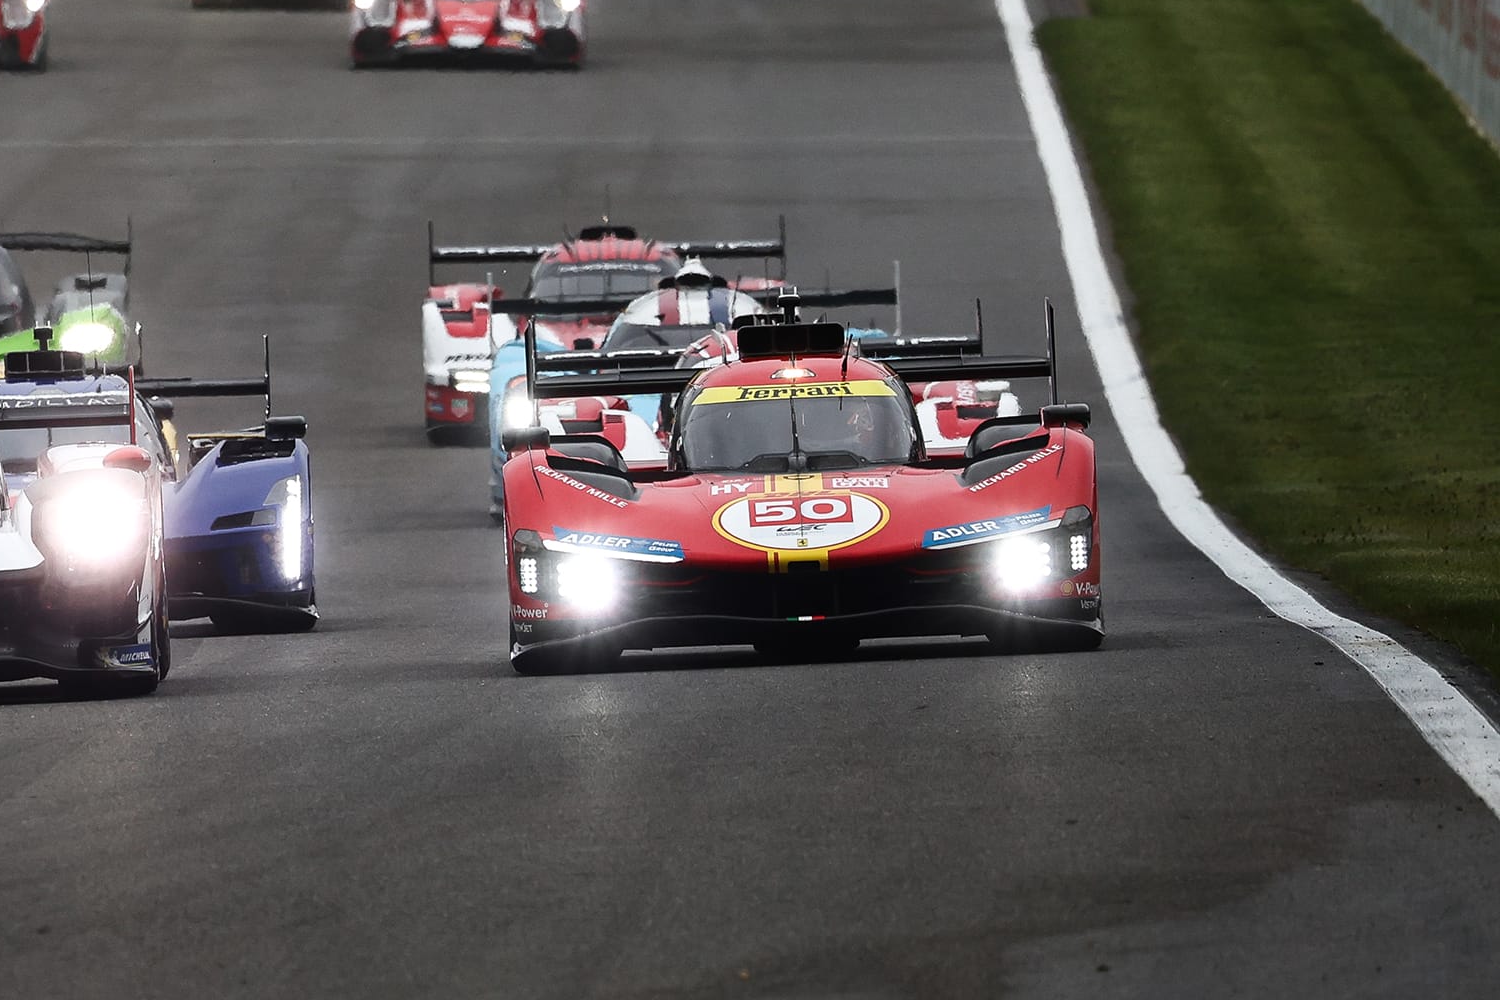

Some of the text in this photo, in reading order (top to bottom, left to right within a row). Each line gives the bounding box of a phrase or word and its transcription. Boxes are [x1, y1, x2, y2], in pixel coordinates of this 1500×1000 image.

[736, 382, 854, 400] Ferrari
[970, 444, 1063, 493] RICHARD MILLE
[533, 465, 628, 508] RICHARD MILLE
[710, 482, 752, 496] HY
[754, 498, 847, 523] 50
[560, 533, 631, 548] ADLER
[933, 521, 1000, 541] ADLER
